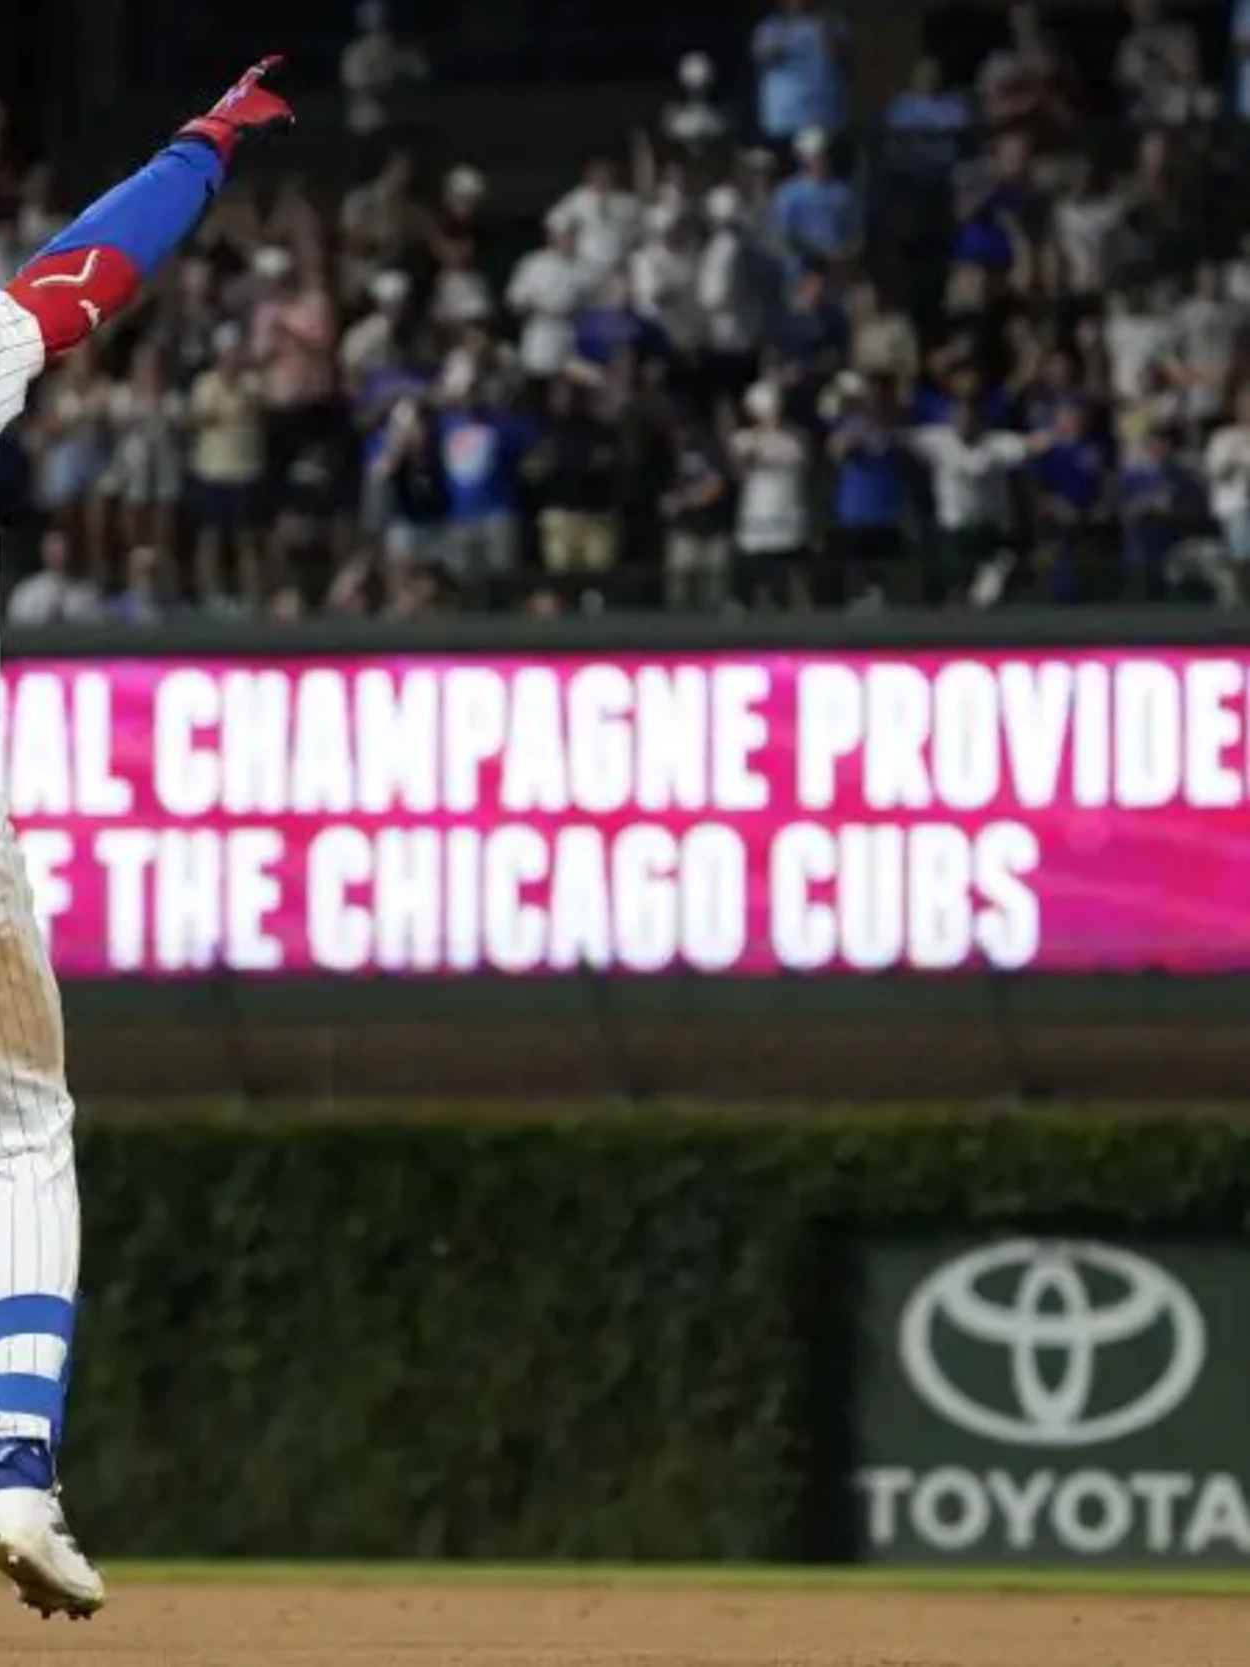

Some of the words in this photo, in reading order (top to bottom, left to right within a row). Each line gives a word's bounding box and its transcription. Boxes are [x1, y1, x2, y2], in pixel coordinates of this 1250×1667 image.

[152, 664, 772, 817] CHAMPAGNE
[795, 660, 1250, 809] PROVIDE
[93, 827, 284, 970] THE
[306, 821, 747, 970] CHICAGO
[769, 820, 1040, 969] CUBS
[860, 1465, 1250, 1553] TOYOTA
